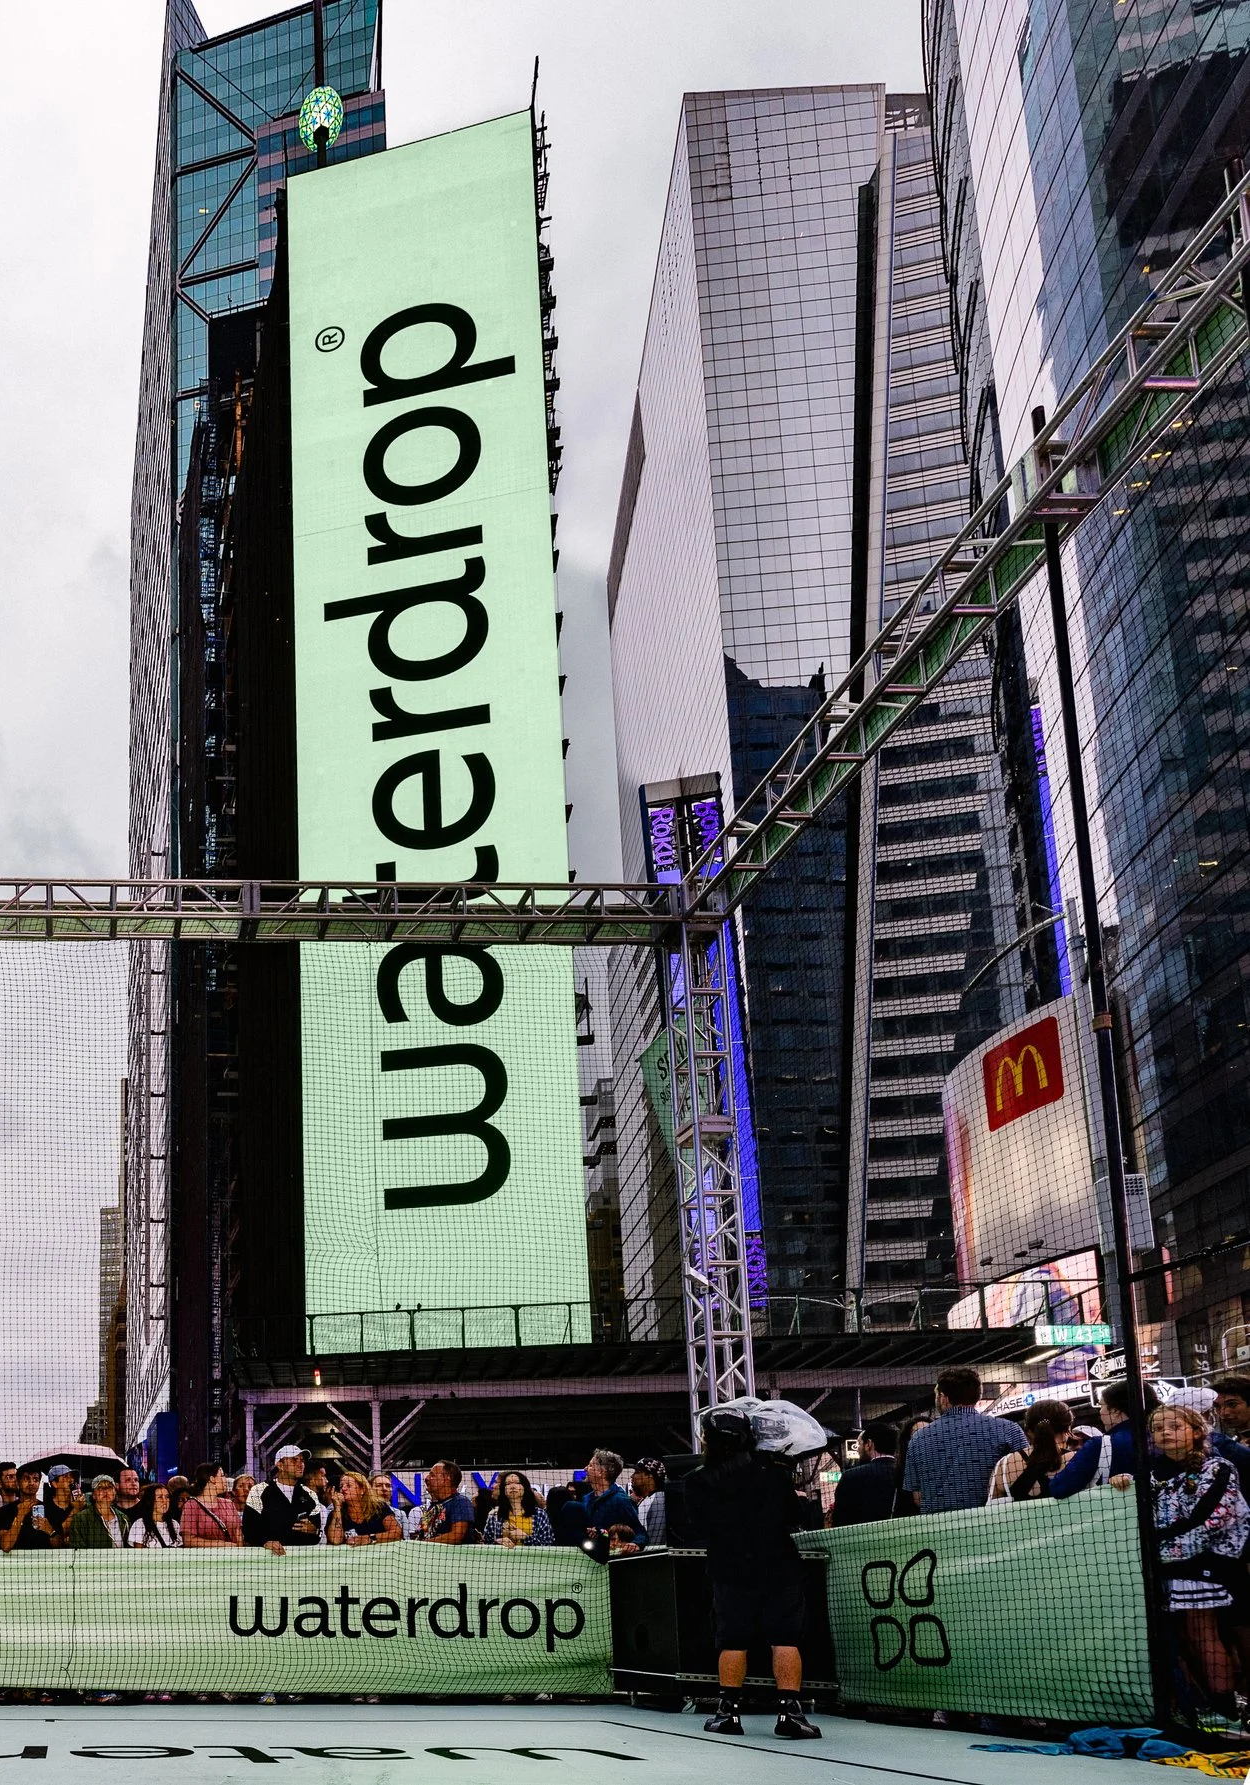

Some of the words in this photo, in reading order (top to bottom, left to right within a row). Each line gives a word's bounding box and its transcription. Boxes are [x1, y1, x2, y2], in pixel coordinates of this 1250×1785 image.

[651, 807, 674, 866] ROKU
[1054, 1327, 1068, 1343] W
[1075, 1327, 1093, 1343] 43
[1098, 1326, 1109, 1338] St
